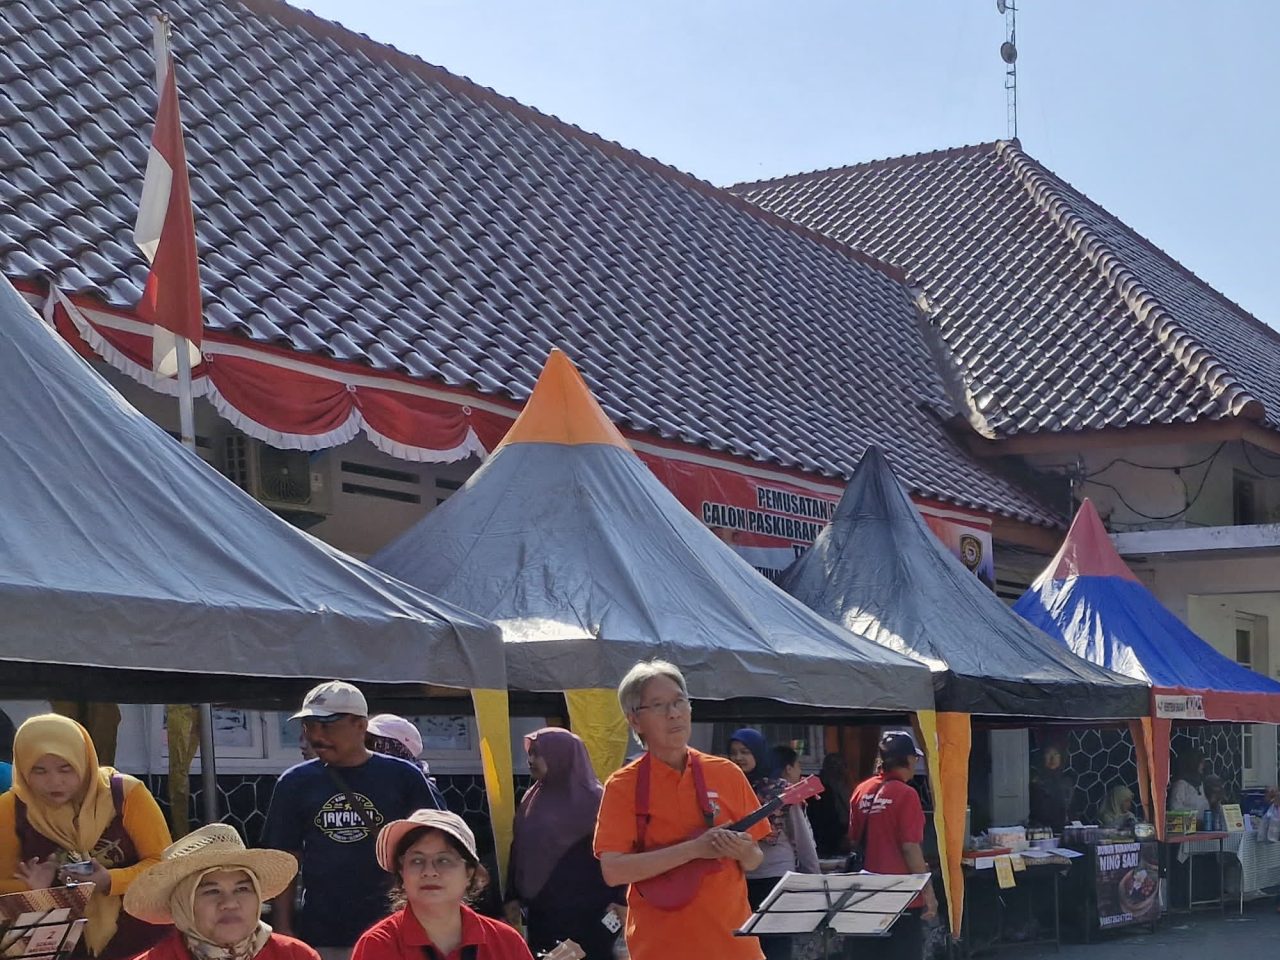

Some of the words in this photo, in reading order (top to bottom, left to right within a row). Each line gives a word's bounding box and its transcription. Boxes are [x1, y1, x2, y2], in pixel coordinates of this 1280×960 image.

[702, 501, 746, 531] CALON
[757, 486, 828, 520] PEMUSATAN
[1100, 854, 1121, 871] NING
